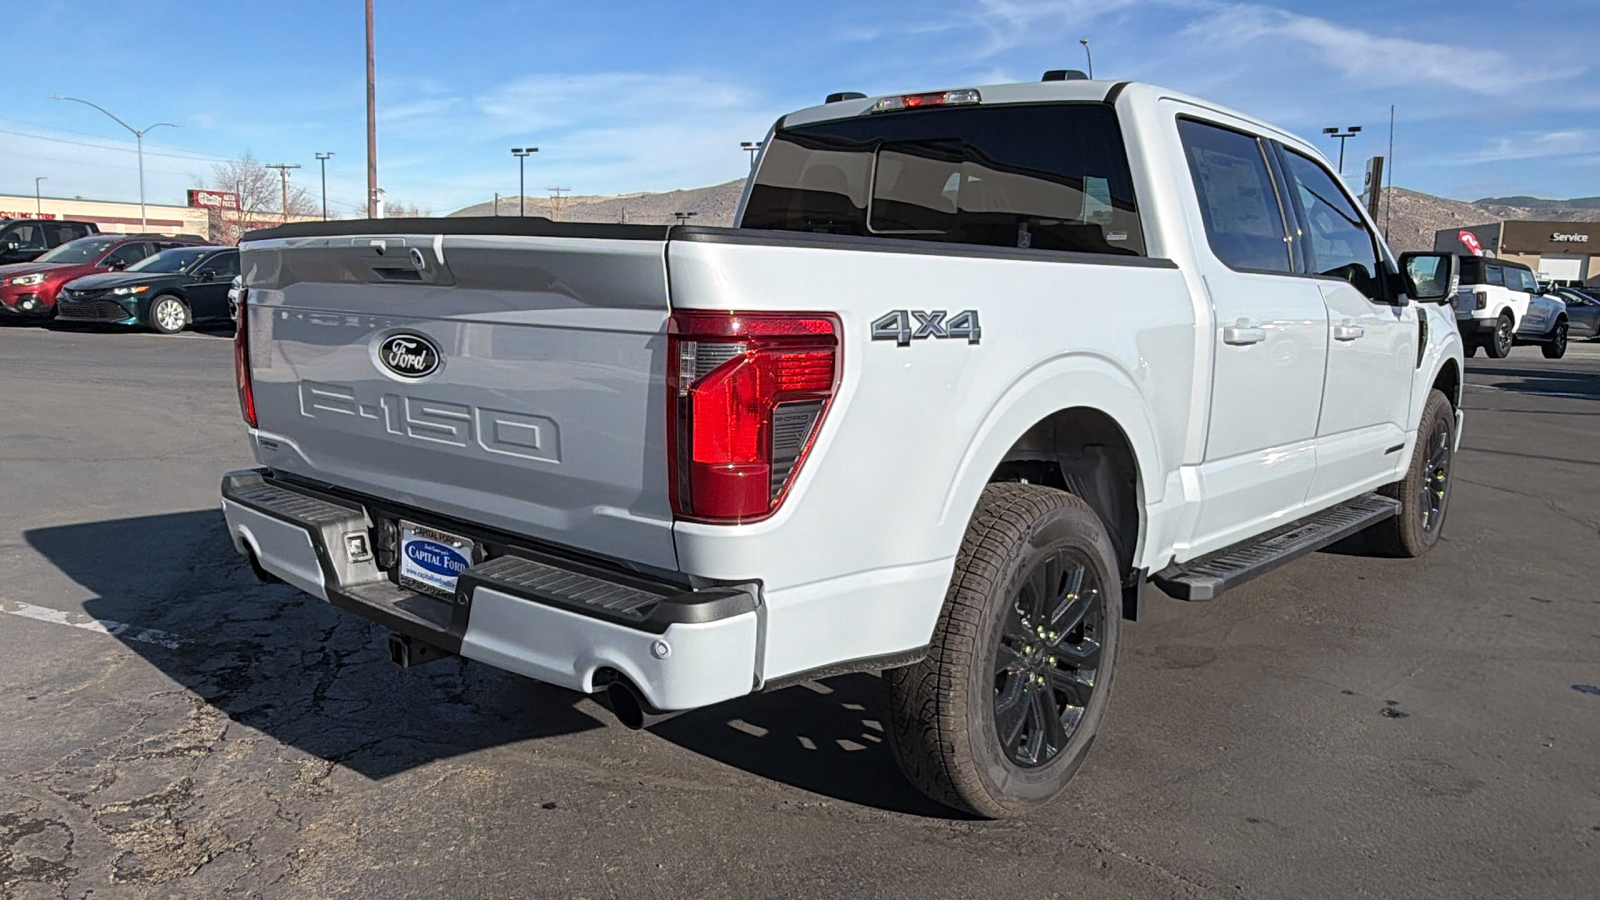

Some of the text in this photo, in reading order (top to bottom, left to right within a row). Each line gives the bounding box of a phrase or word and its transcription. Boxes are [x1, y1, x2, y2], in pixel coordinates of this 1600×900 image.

[1552, 232, 1589, 243] Service
[388, 339, 427, 371] Ford
[298, 379, 563, 465] F-150
[414, 526, 456, 543] CAPITAL FORD
[408, 545, 442, 567] CAPITAL
[444, 556, 466, 573] FORD
